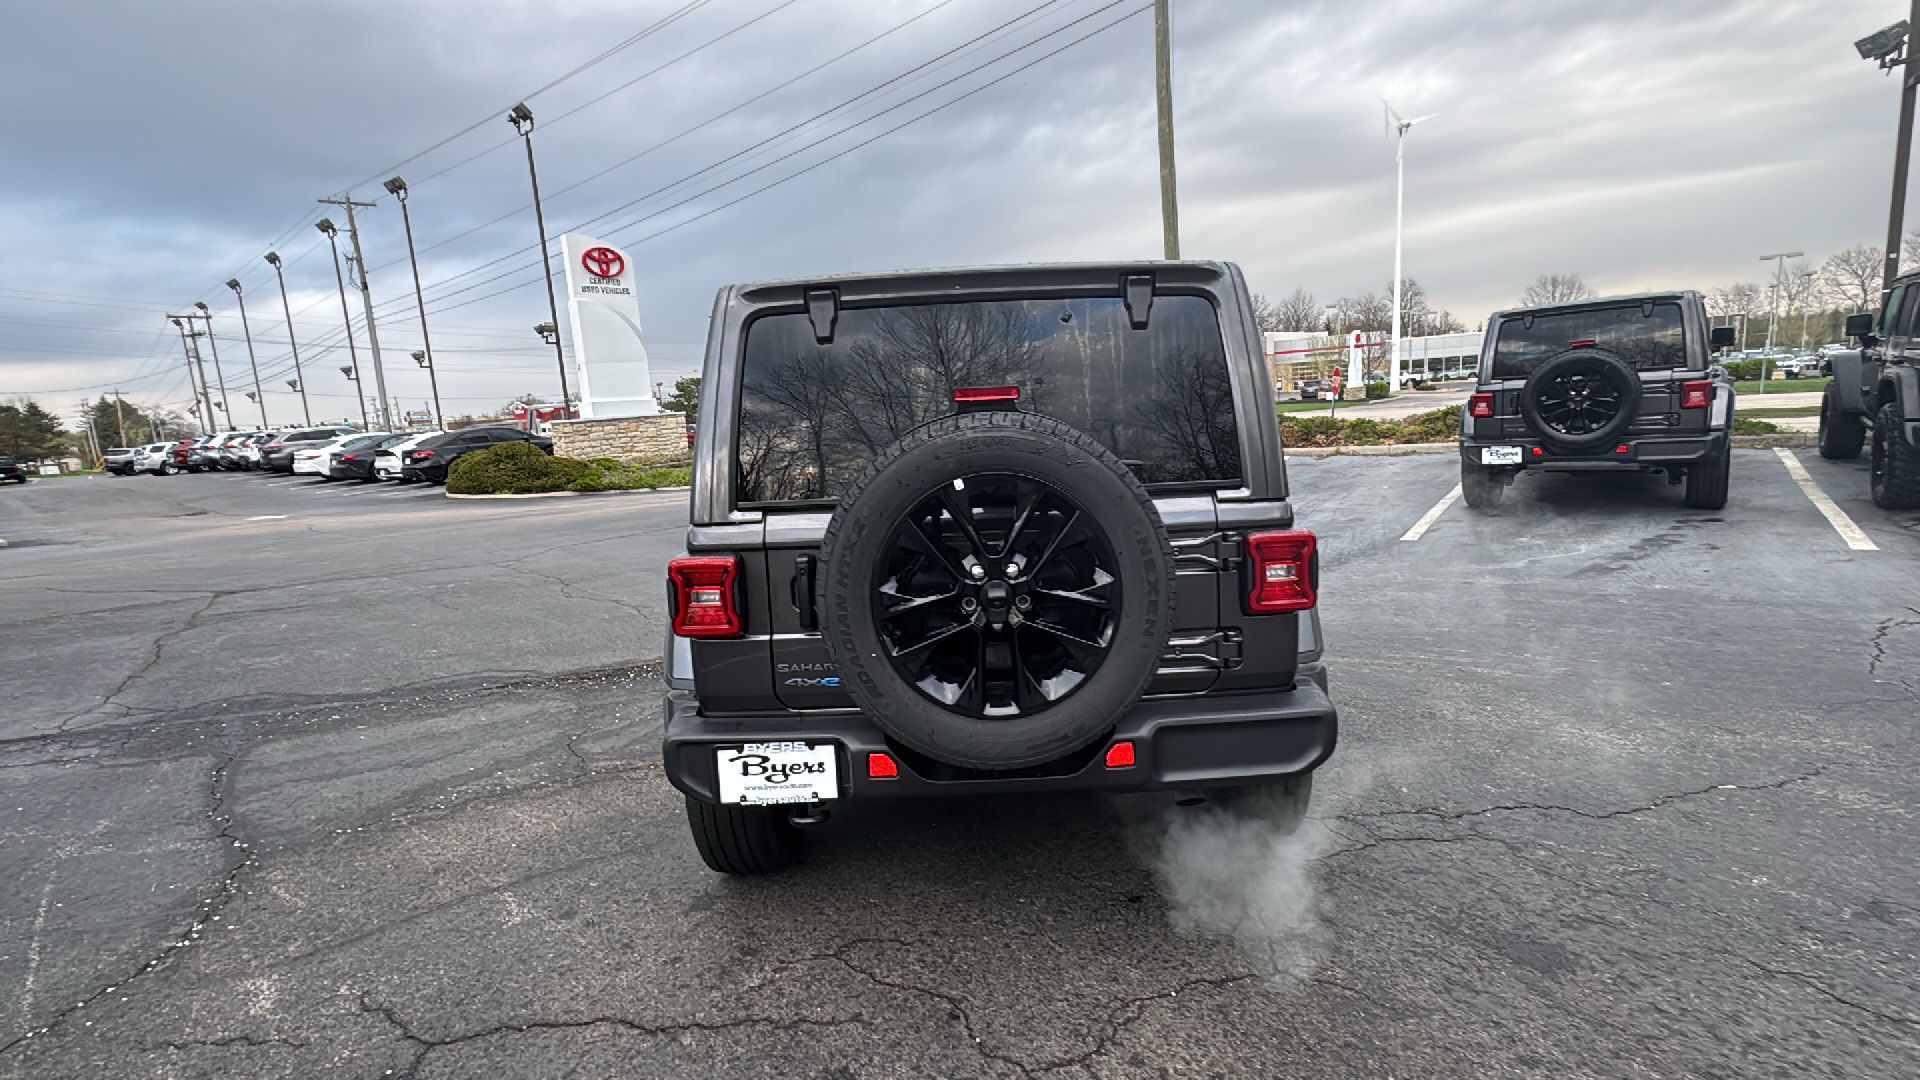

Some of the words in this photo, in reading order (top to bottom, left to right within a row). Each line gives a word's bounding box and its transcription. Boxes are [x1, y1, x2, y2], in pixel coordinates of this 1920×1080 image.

[589, 277, 621, 286] CERTIFIED
[600, 286, 631, 295] VEHICLES
[1136, 535, 1159, 637] NEXEN
[777, 663, 840, 672] SAHAR
[743, 741, 807, 753] BYERS
[728, 754, 826, 784] Byers
